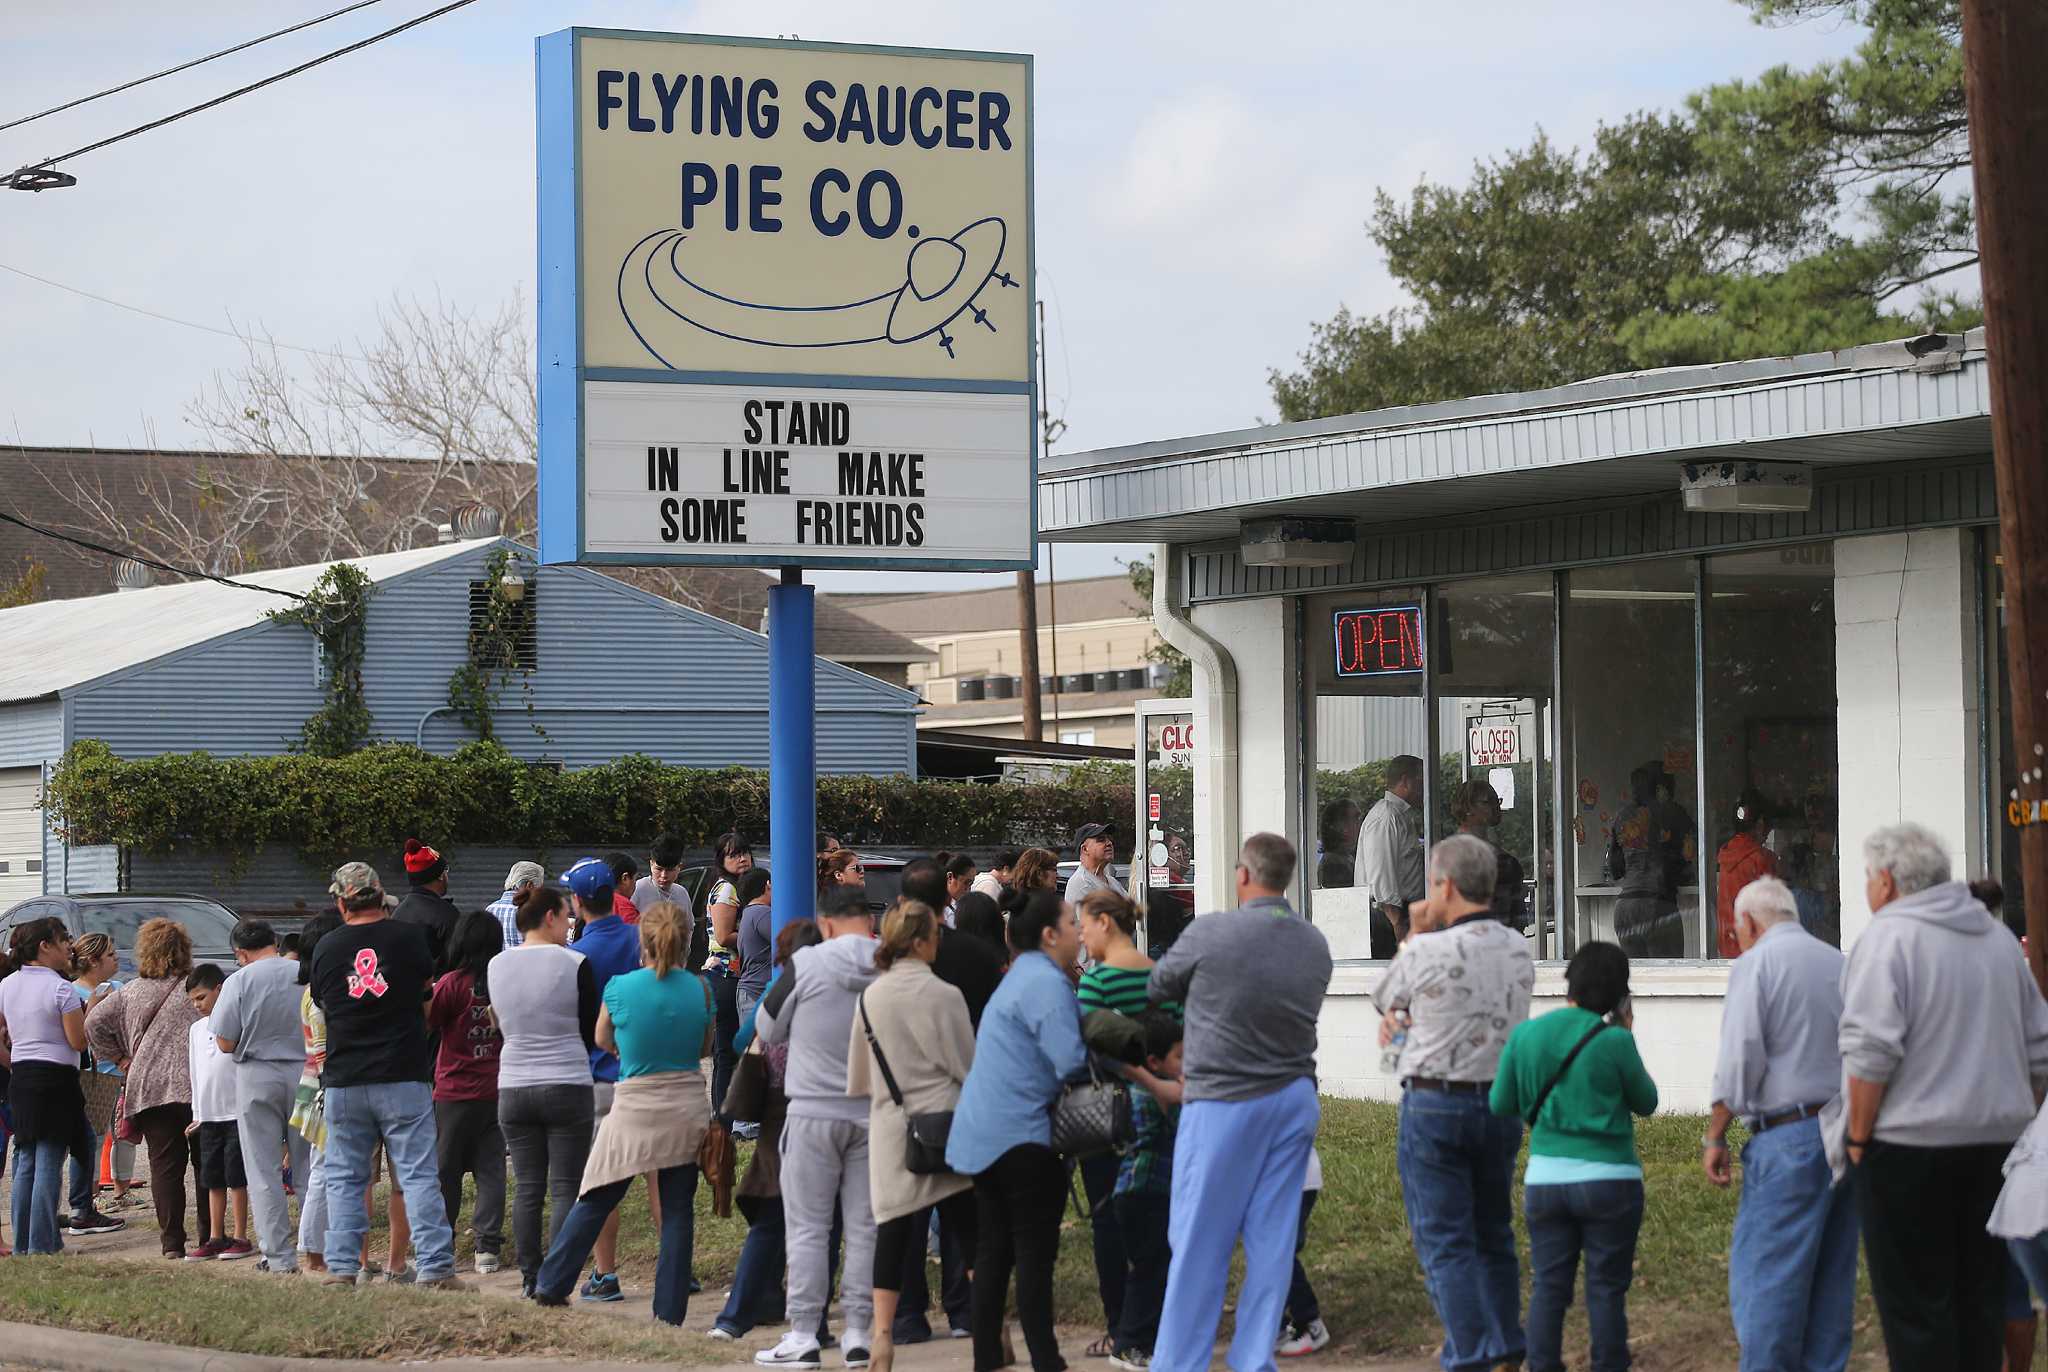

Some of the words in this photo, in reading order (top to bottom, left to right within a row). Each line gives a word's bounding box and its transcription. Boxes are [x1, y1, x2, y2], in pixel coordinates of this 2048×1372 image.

[597, 70, 780, 140] FLYING
[802, 79, 1013, 151] SAUCER
[681, 162, 783, 232] PIE
[809, 167, 920, 240] CO.
[743, 399, 850, 446] STAND
[647, 446, 679, 492] IN
[723, 448, 791, 495] LINE
[838, 452, 925, 498] MAKE
[660, 497, 747, 543] SOME
[796, 500, 924, 547] FRIENDS
[1338, 612, 1423, 672] OPEN
[1171, 752, 1191, 764] SUN
[1471, 729, 1516, 755] CLOSED
